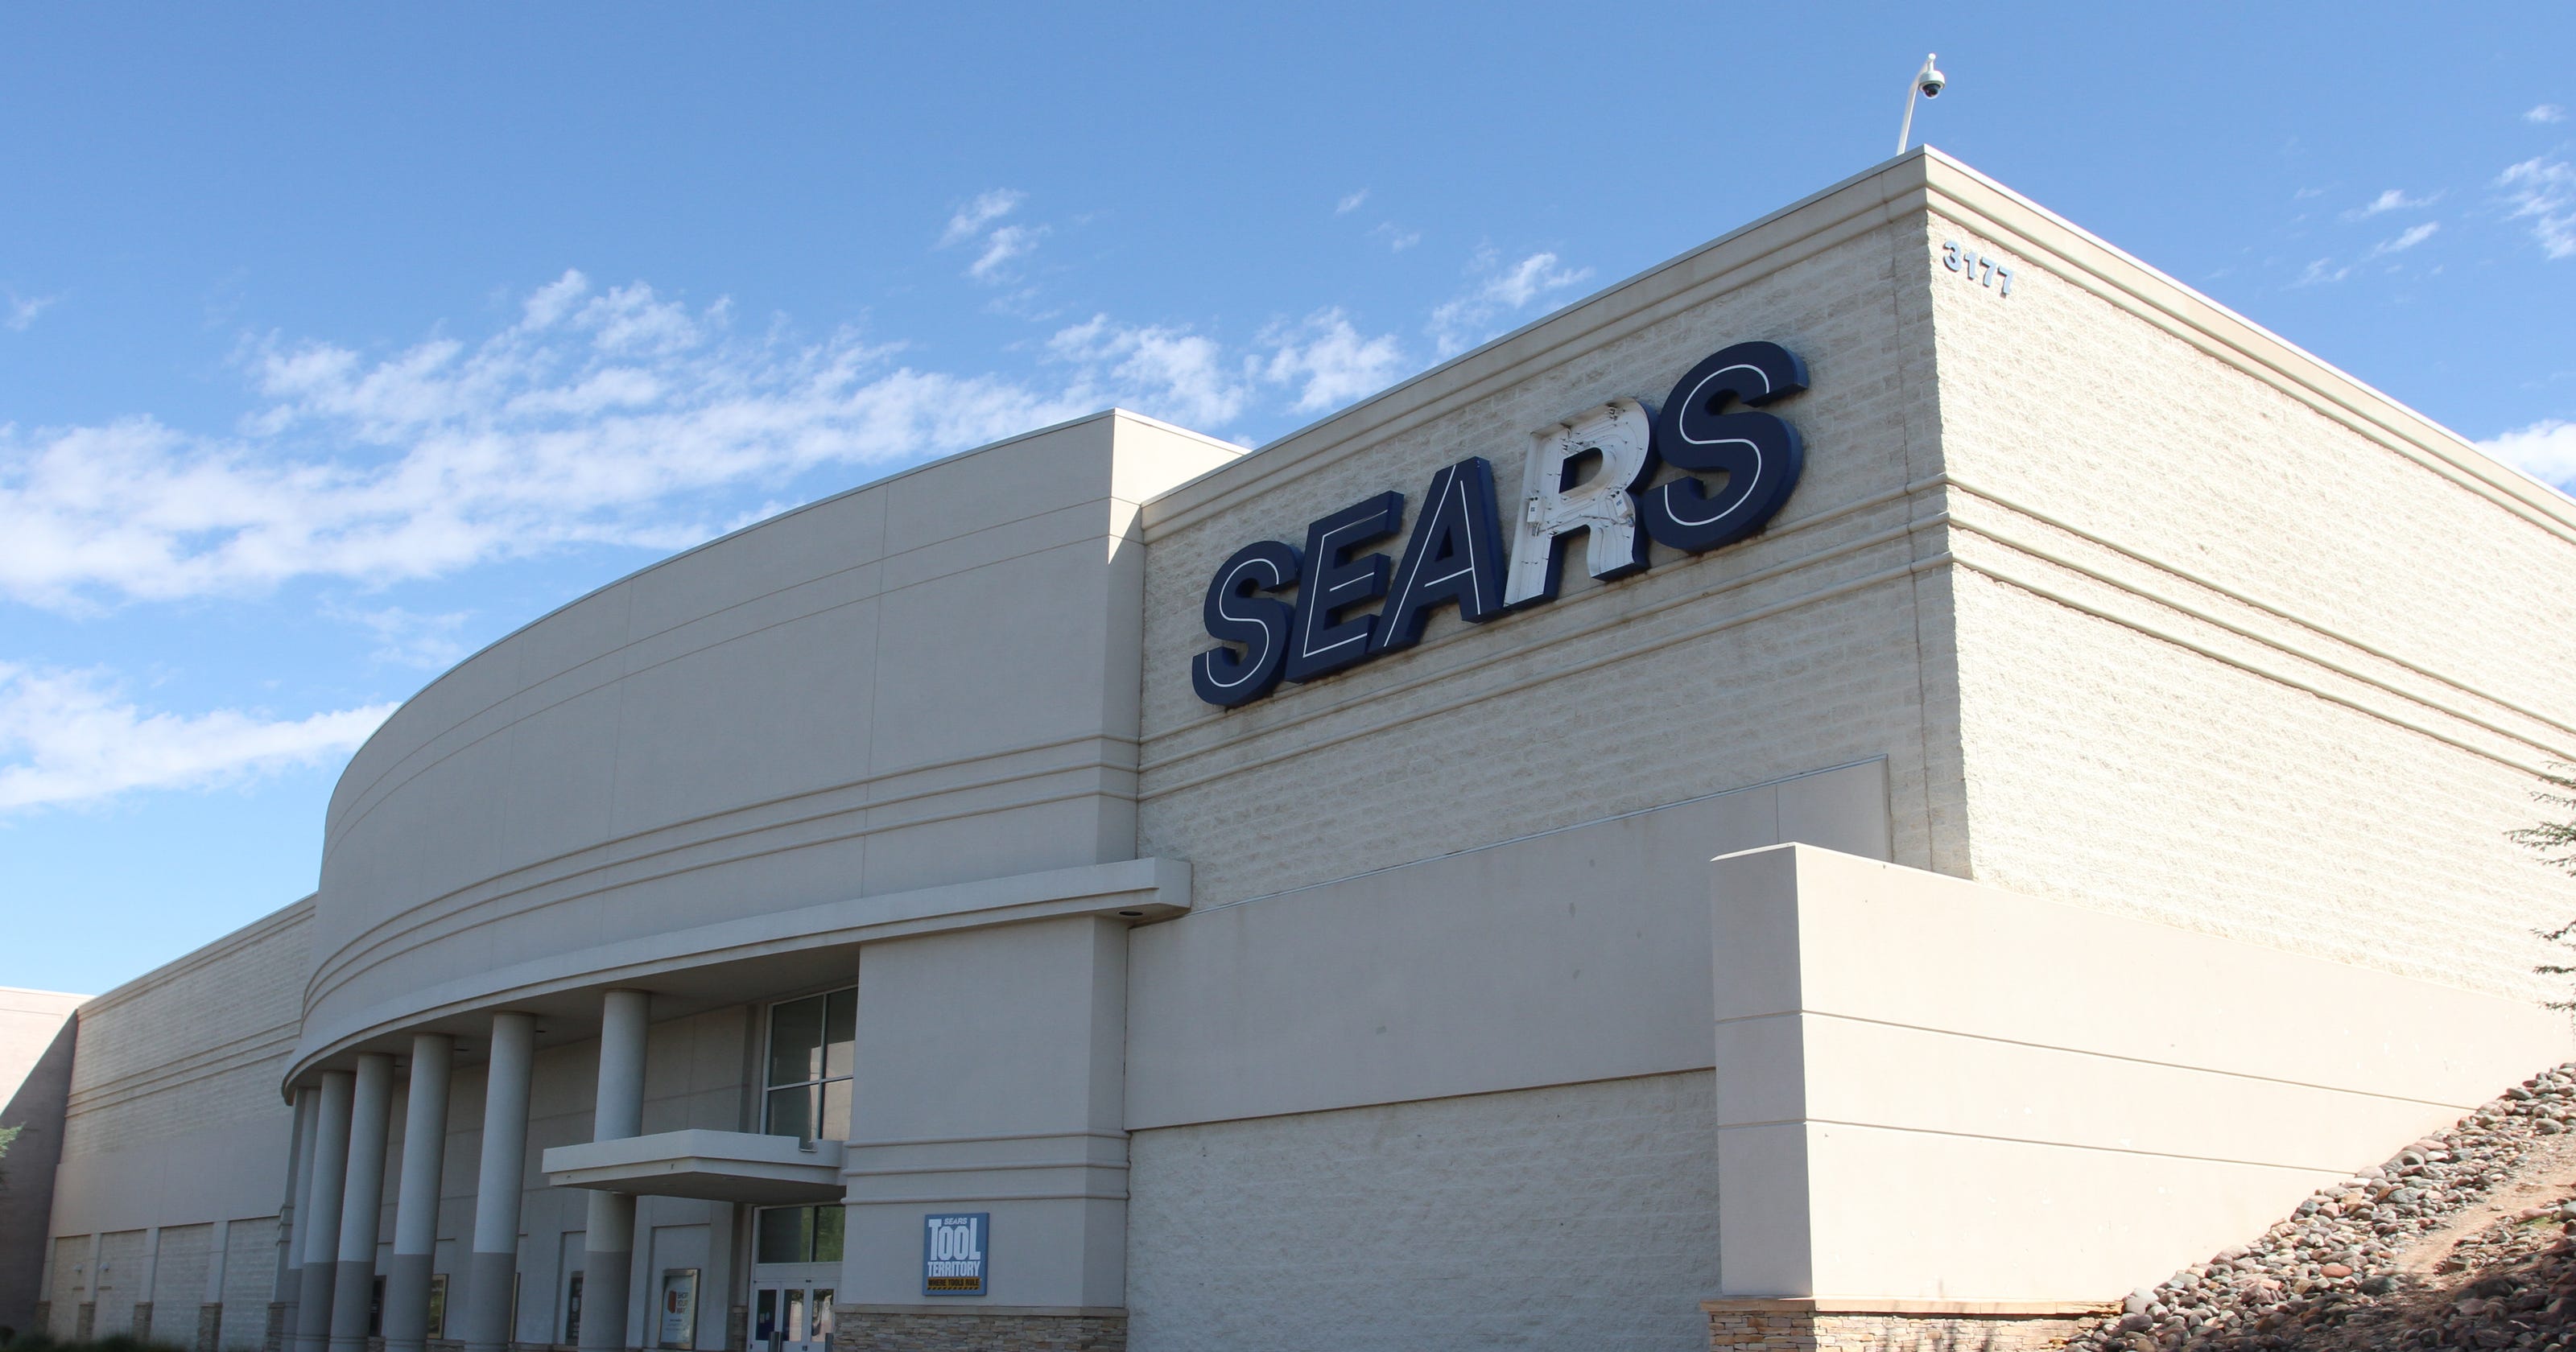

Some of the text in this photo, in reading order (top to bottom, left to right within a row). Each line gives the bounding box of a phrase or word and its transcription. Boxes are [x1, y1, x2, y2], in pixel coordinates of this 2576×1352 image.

[1942, 241, 2015, 295] 3177
[1191, 340, 1809, 707] SEARS
[928, 1218, 980, 1260] TOOL
[927, 1261, 980, 1277] TERRITORY
